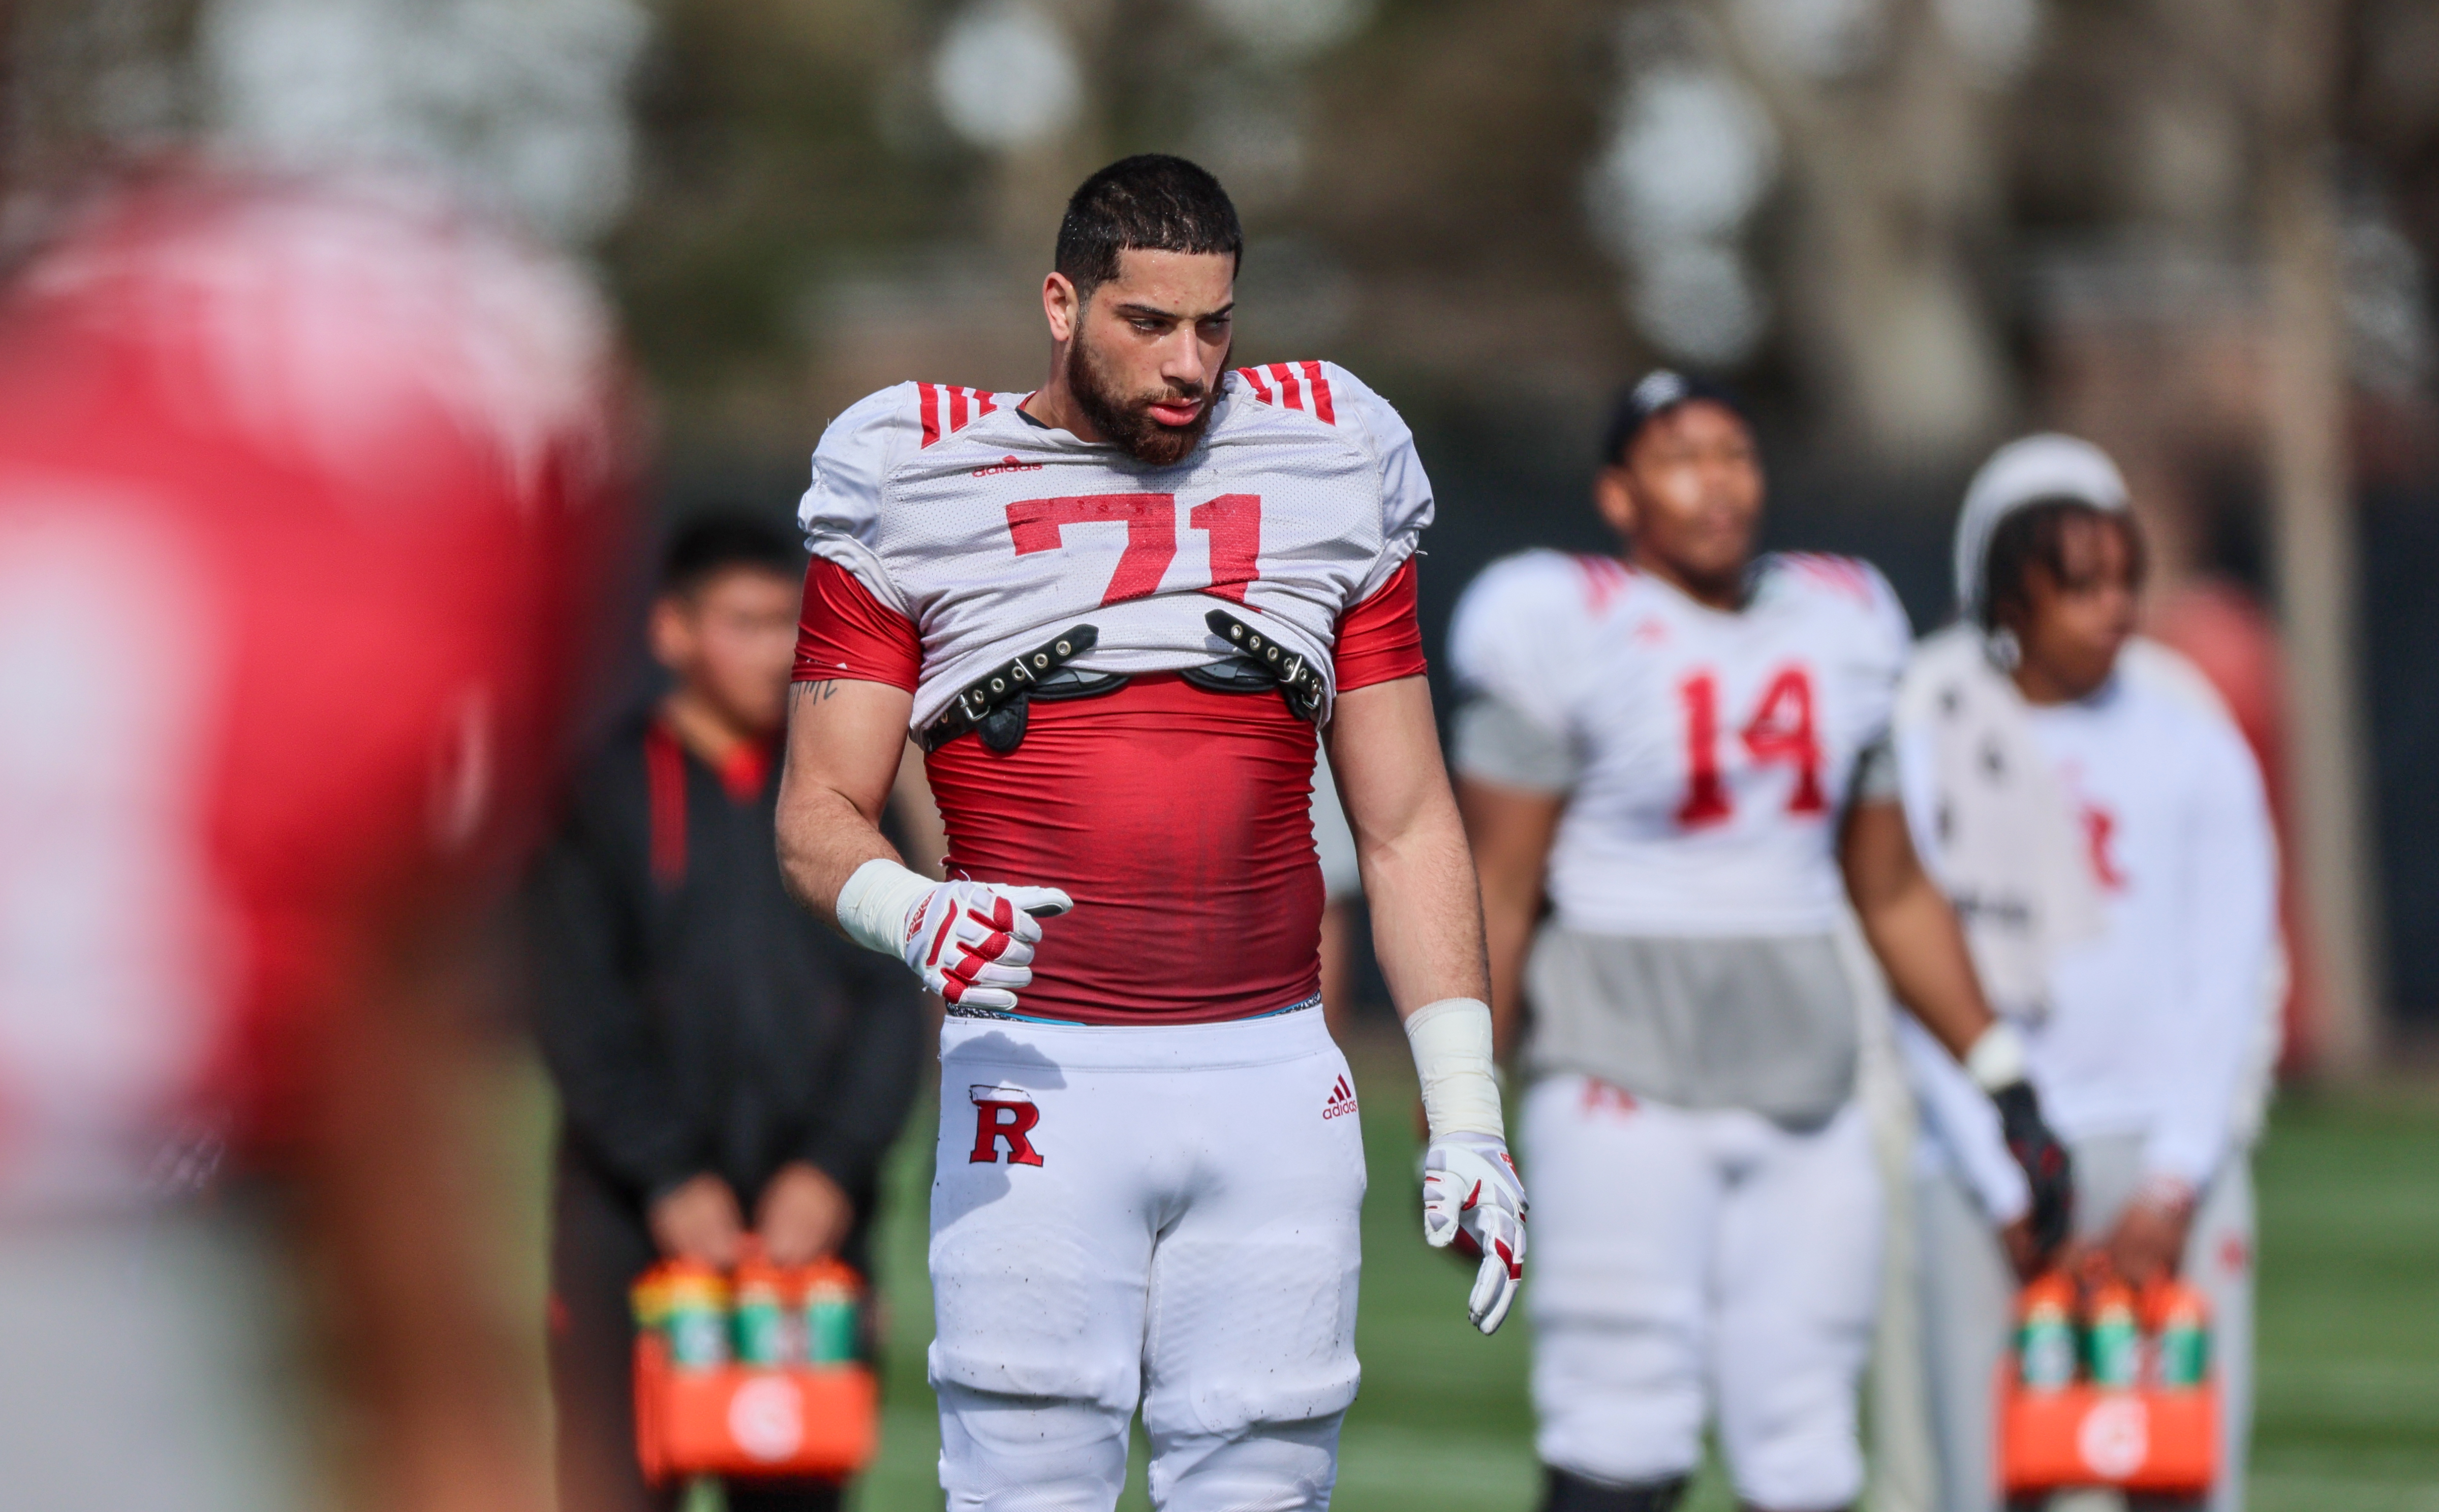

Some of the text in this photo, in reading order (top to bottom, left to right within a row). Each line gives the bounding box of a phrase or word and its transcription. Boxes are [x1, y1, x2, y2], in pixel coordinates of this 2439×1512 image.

[1006, 493, 1261, 612] 71
[1676, 665, 1834, 828] 14
[969, 1085, 1044, 1167] R
[1323, 1099, 1357, 1120] adidas
